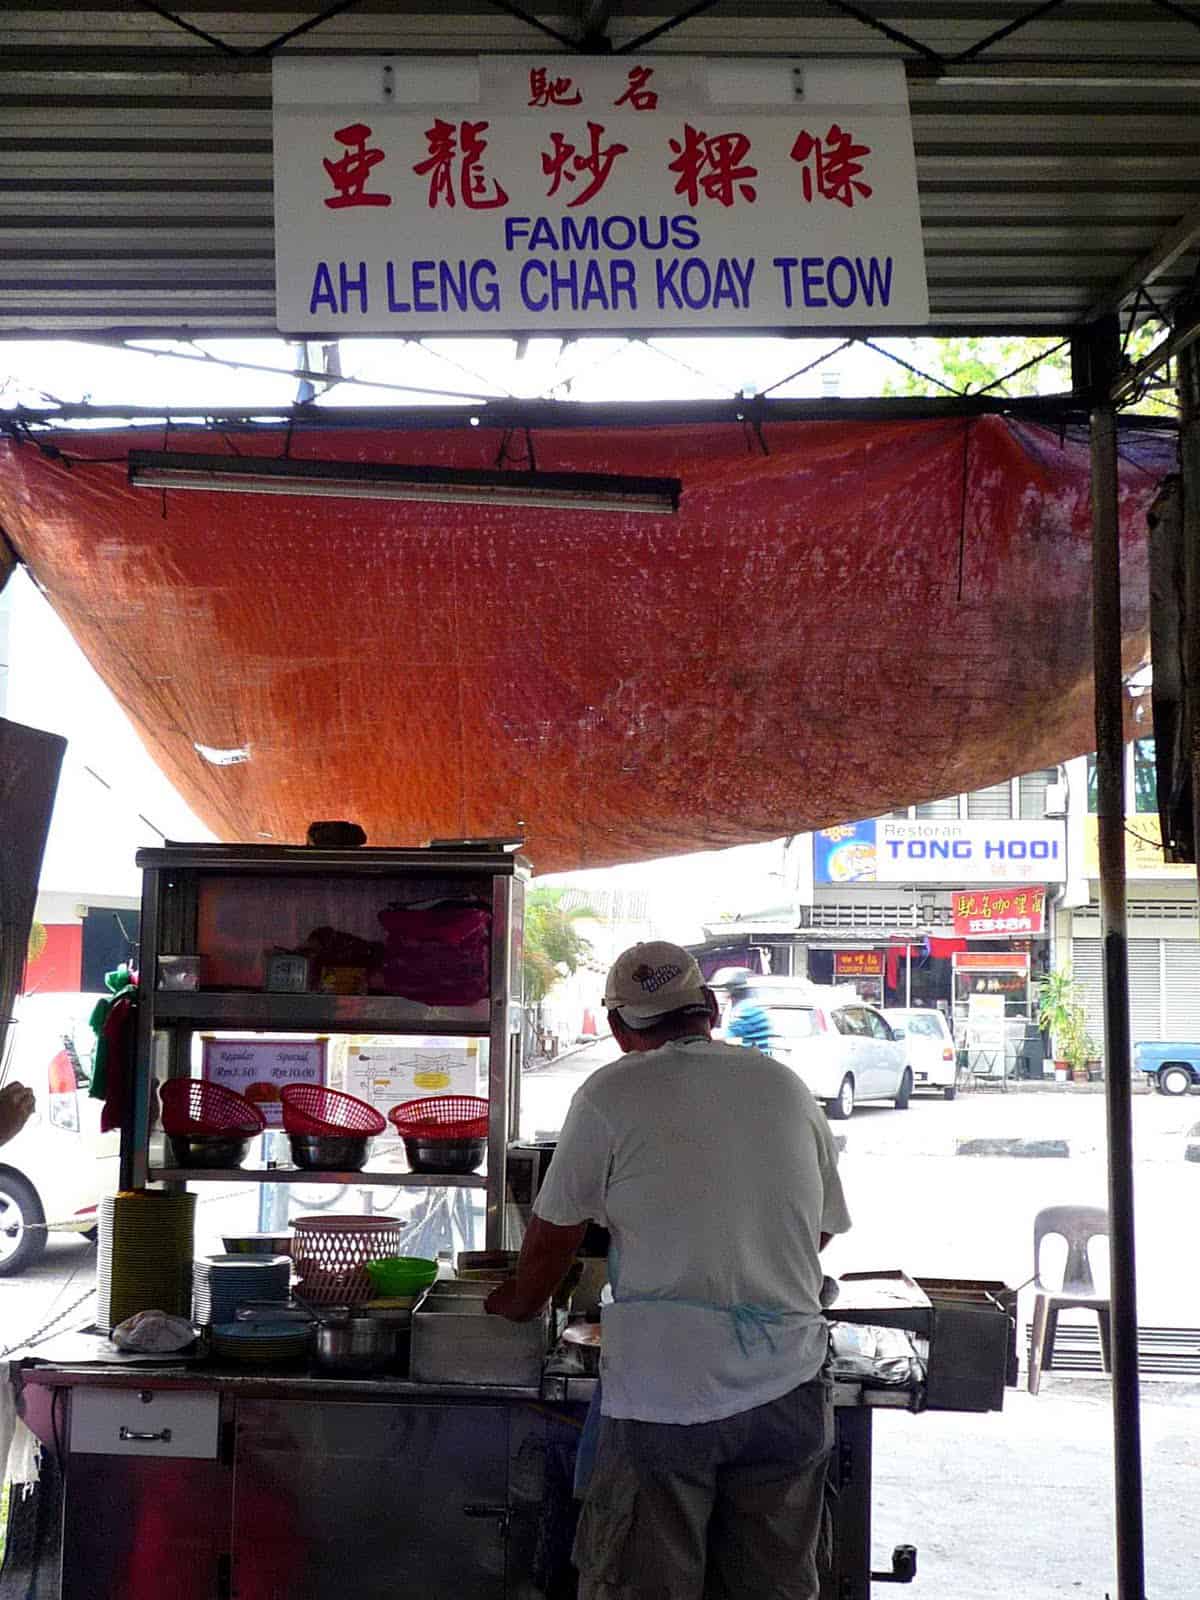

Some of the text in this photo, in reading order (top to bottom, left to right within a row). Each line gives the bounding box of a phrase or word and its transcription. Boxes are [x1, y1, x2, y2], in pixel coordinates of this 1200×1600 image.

[528, 67, 658, 110] 馳名
[505, 215, 700, 251] FAMOUS
[310, 256, 893, 313] AH LENG CHAR KOAY TEOW
[884, 824, 962, 837] Restoran
[886, 840, 1058, 859] TONG HOOI
[275, 1051, 309, 1063] Special
